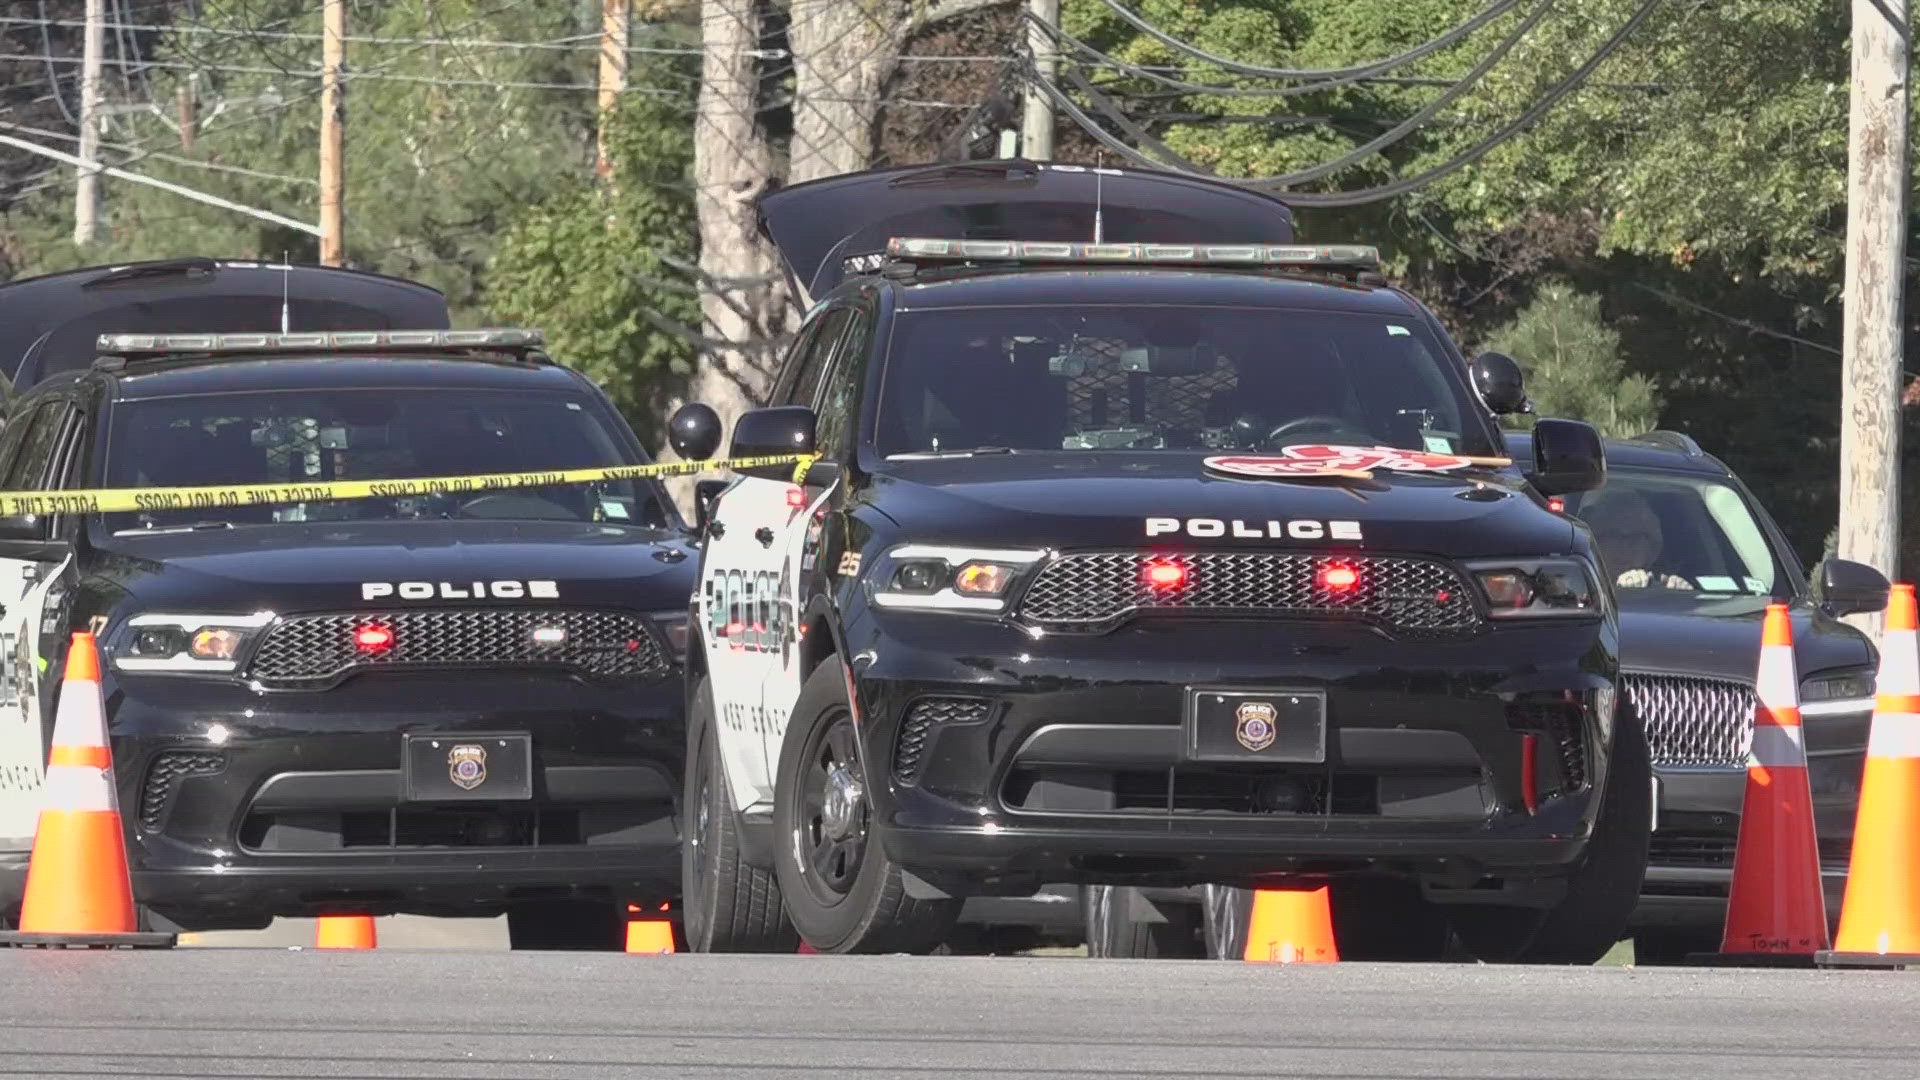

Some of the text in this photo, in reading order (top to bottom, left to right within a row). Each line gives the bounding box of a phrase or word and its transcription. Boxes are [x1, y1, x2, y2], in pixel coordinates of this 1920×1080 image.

[369, 473, 565, 497] POLICE LINE DO NOT CROSS
[12, 497, 43, 515] LINE
[49, 494, 99, 514] POLICE
[135, 487, 332, 511] POLICE LINE DO NOT CROSS
[1146, 518, 1363, 540] POLICE
[837, 550, 862, 576] 25
[362, 580, 560, 600] POLICE
